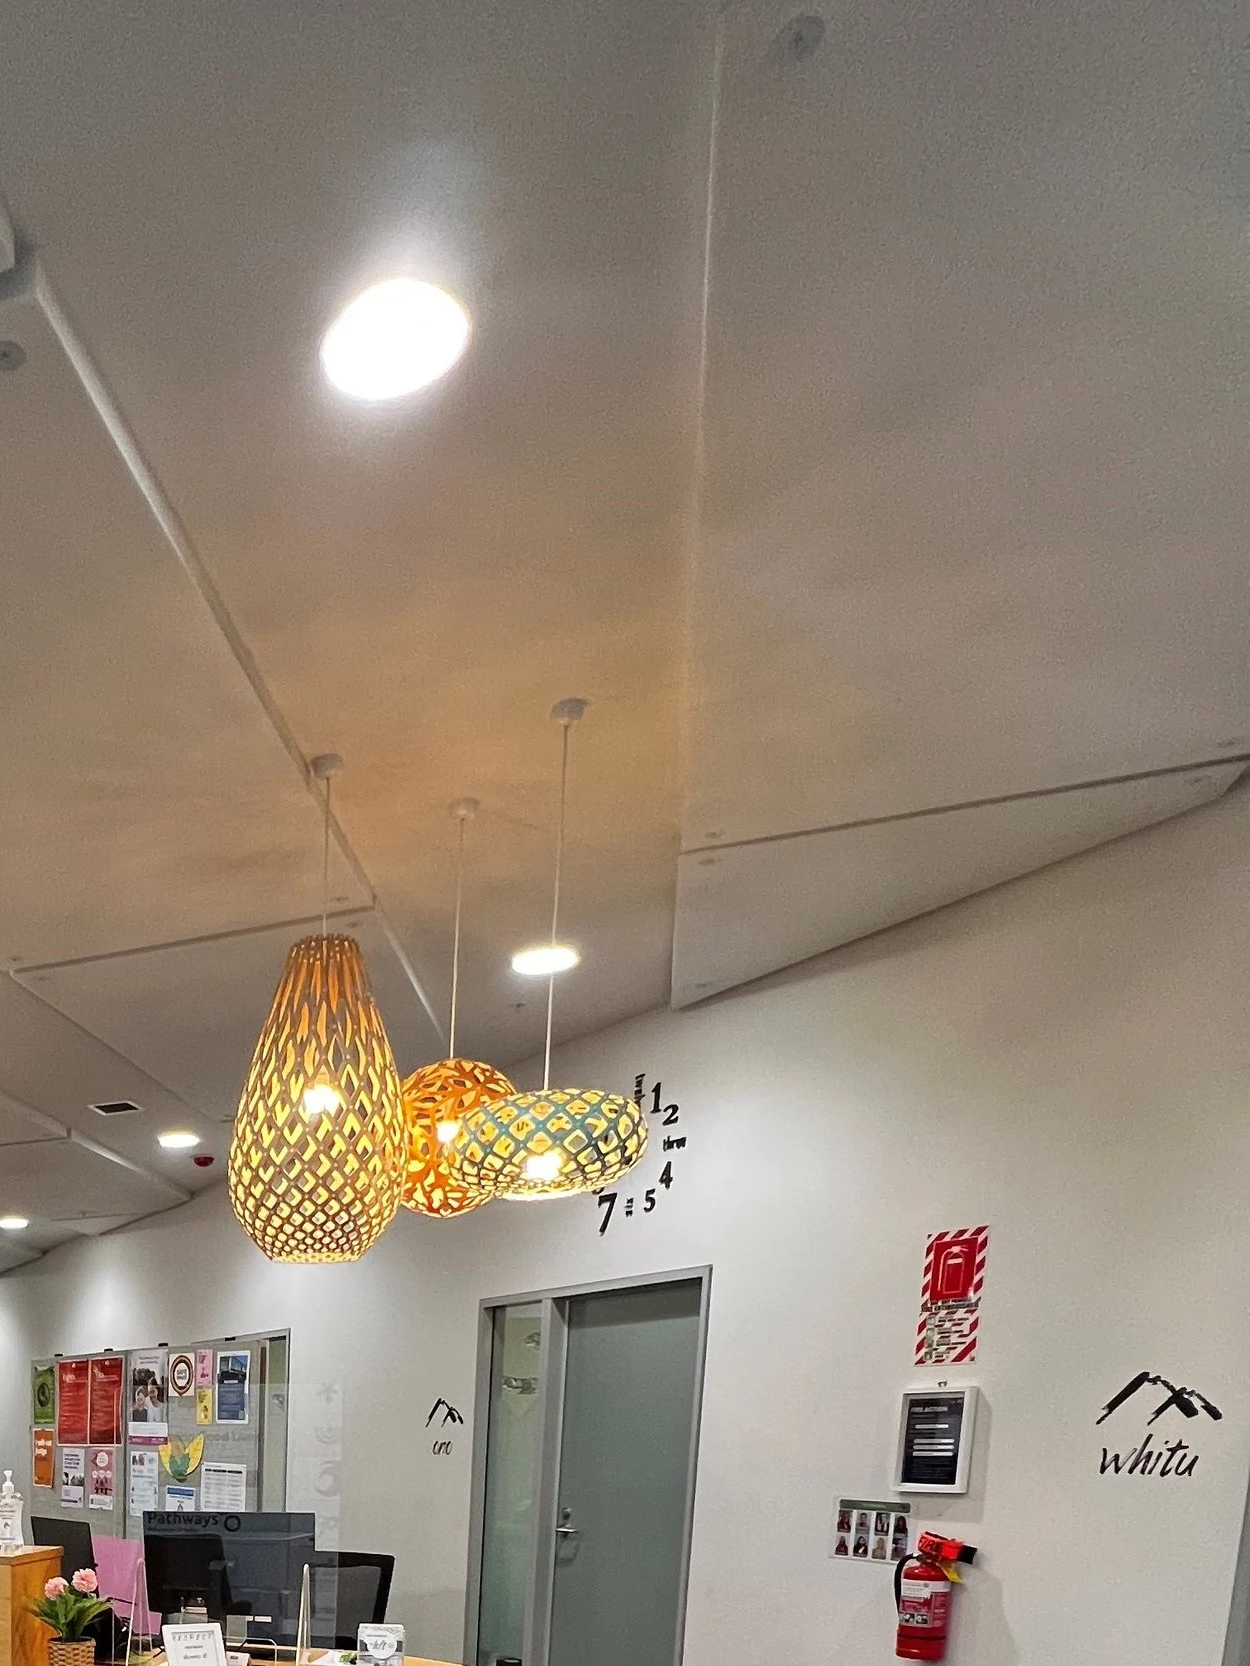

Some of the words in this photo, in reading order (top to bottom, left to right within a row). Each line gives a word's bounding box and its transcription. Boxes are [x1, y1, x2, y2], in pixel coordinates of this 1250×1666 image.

[650, 1082, 661, 1114] 1
[662, 1104, 679, 1126] 2
[659, 1161, 673, 1190] 4
[598, 1192, 618, 1237] 7
[643, 1188, 656, 1213] 5
[1099, 1433, 1199, 1477] whitu
[147, 1511, 219, 1528] Pathways
